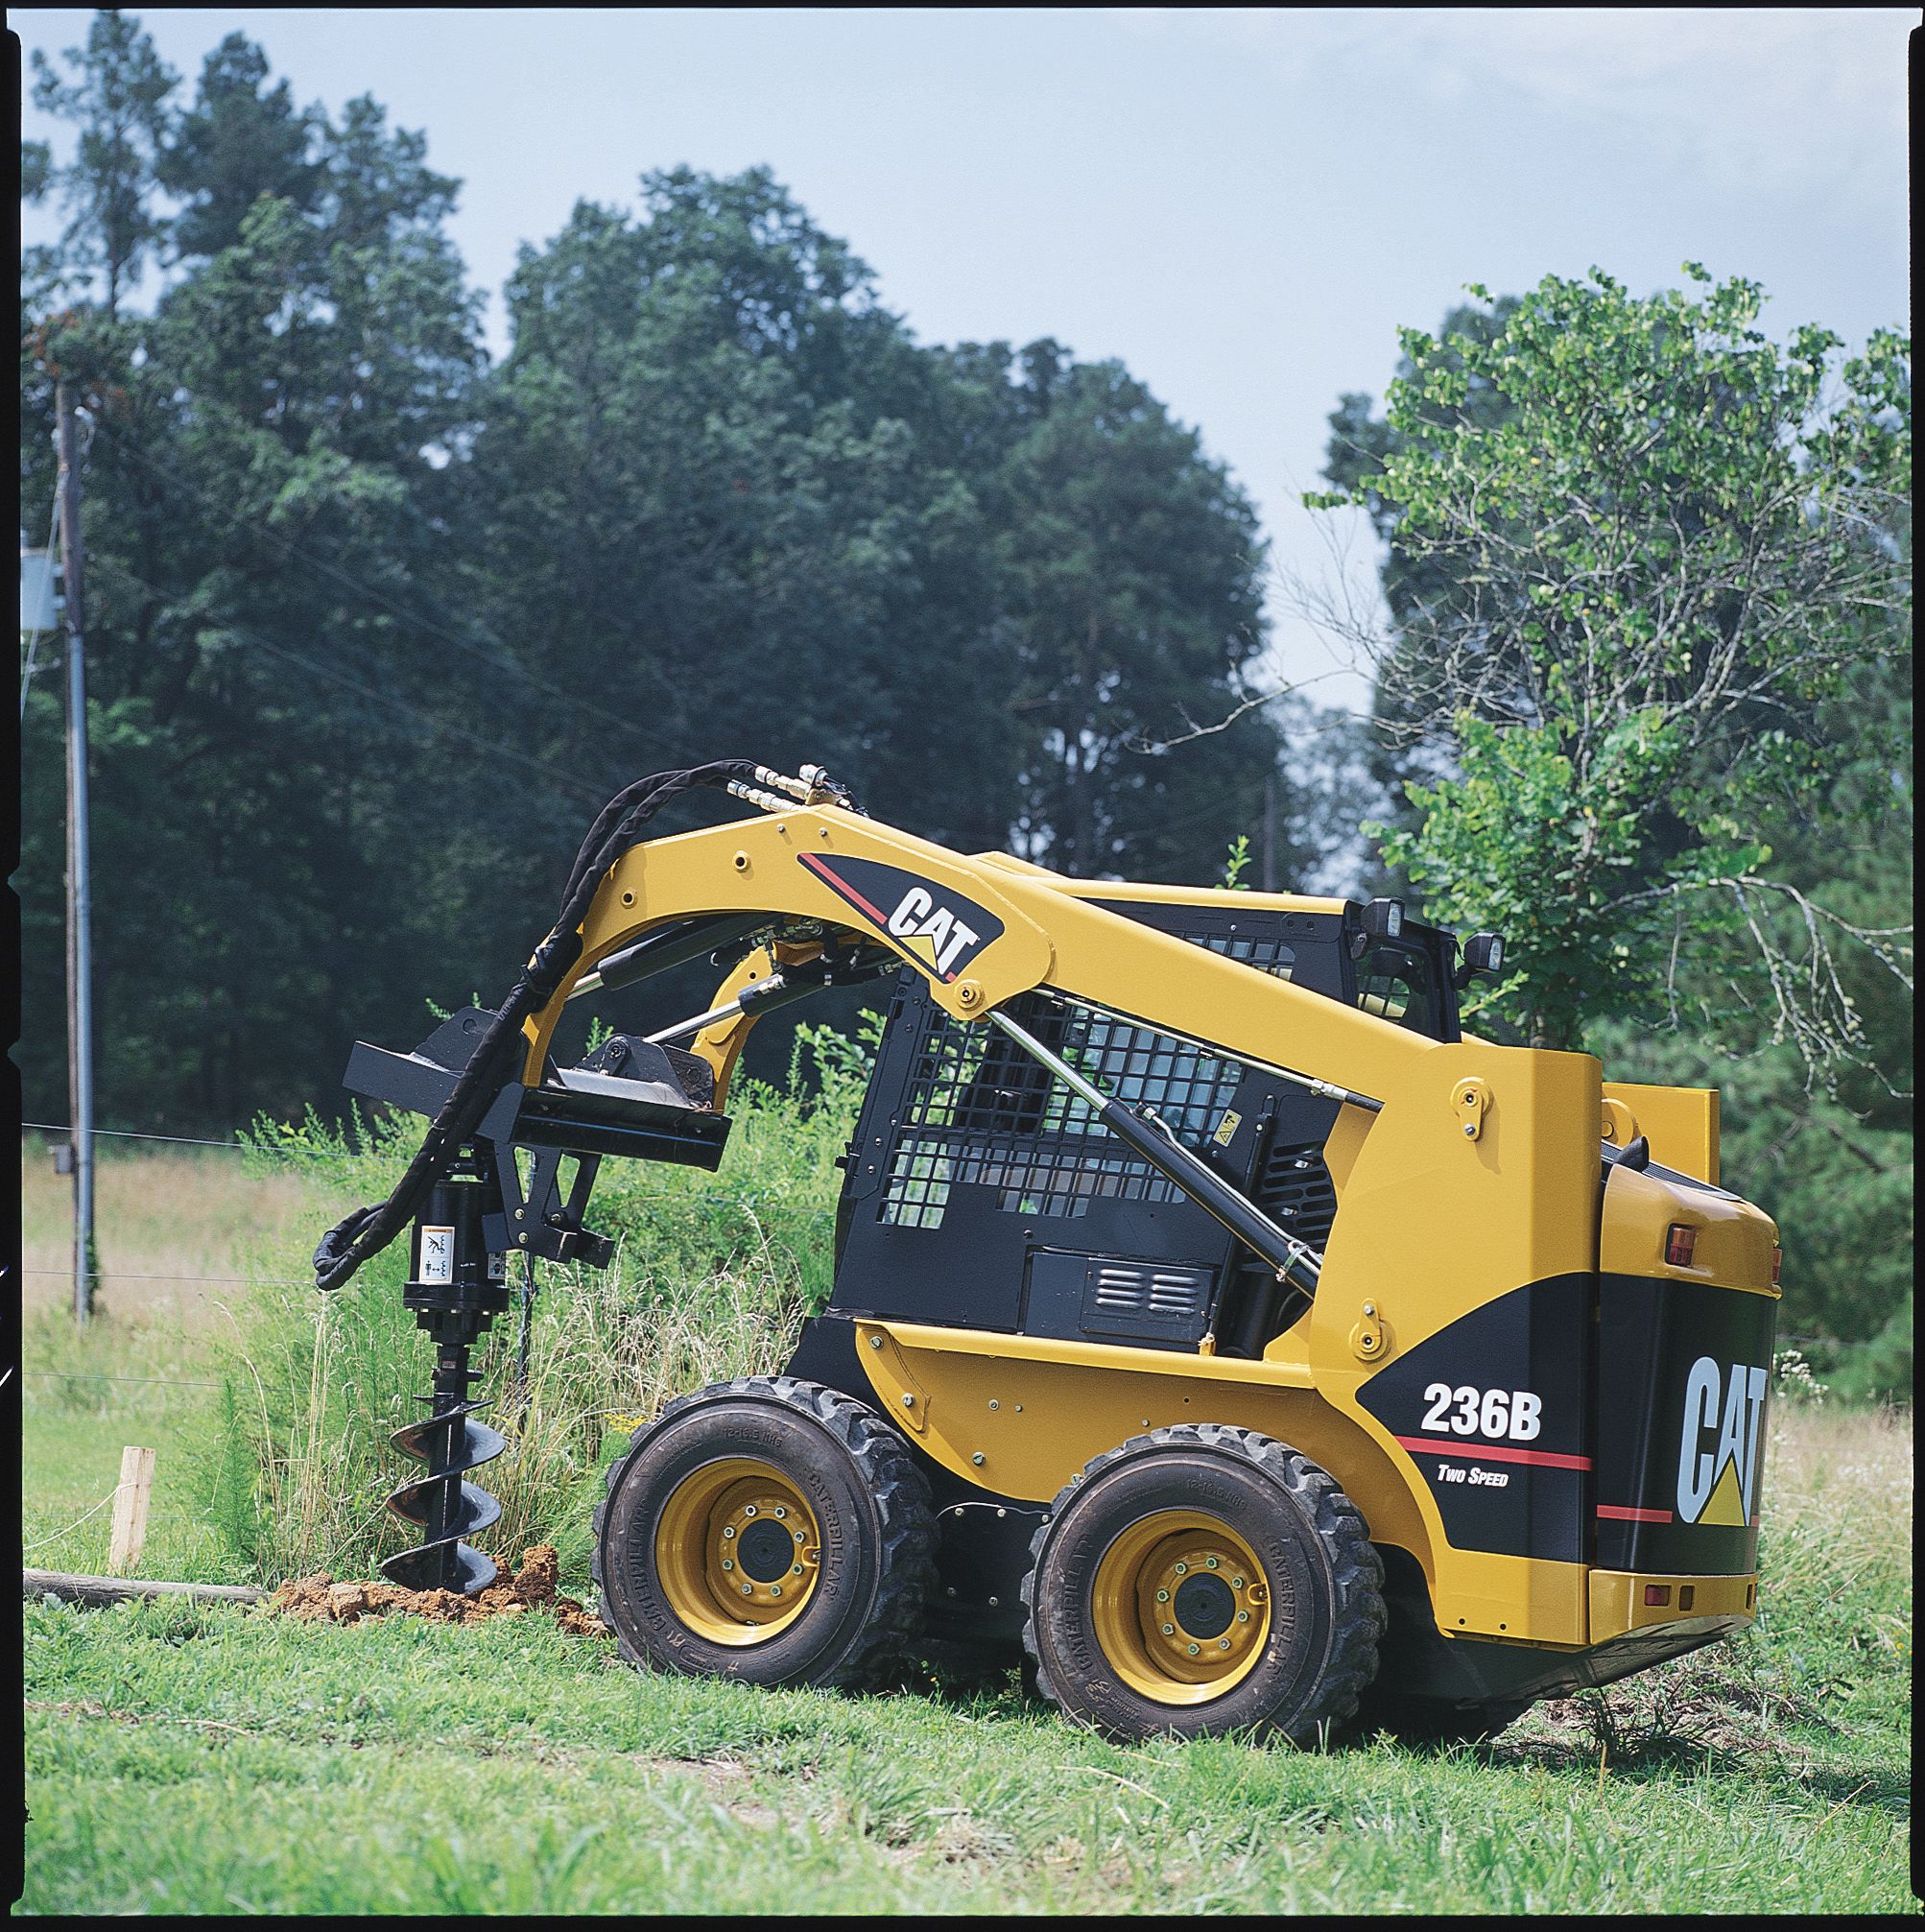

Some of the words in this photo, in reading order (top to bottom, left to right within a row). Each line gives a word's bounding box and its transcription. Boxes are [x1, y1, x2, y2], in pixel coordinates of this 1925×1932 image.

[889, 887, 980, 975] CAT
[1420, 1382, 1542, 1441] 236B
[1676, 1356, 1769, 1527] CAT
[809, 1473, 844, 1597] CATERPILLAR
[1267, 1542, 1295, 1677] CATERPILLAR
